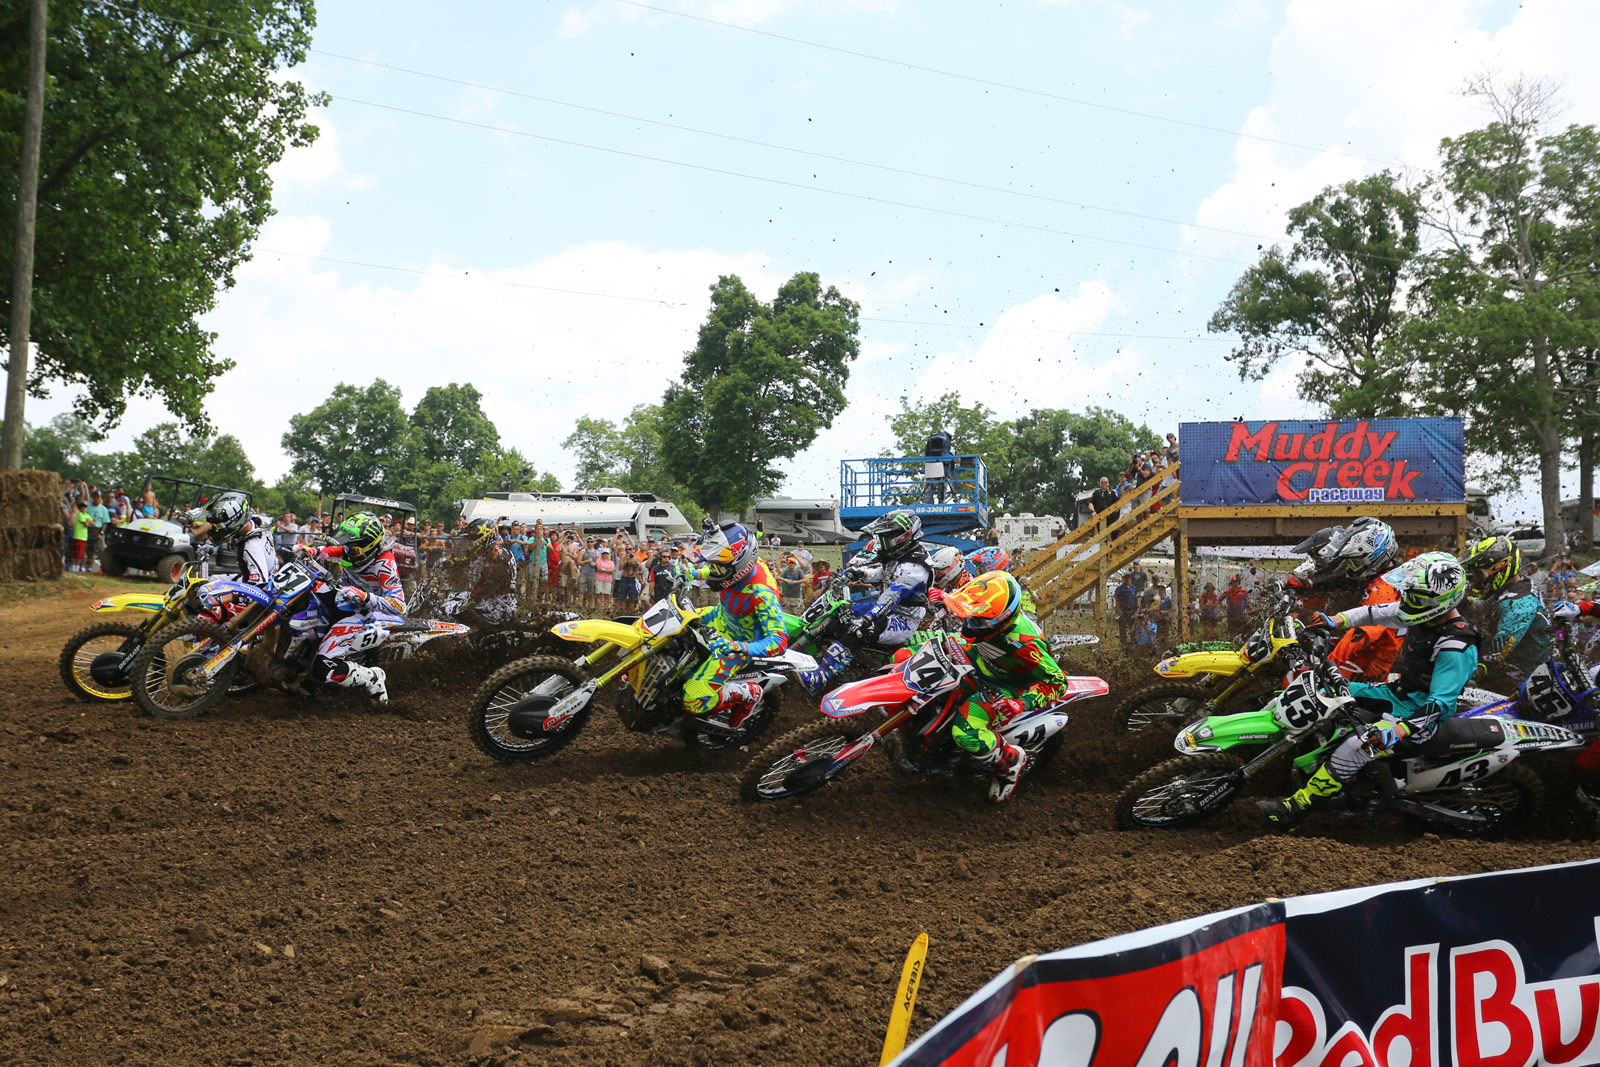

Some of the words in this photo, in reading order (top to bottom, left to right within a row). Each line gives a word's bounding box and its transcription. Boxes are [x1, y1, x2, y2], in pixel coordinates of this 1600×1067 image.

[1225, 421, 1398, 466] Muddy
[1277, 458, 1422, 501] Creek
[1309, 488, 1385, 502] raceway
[274, 564, 310, 593] 51
[720, 573, 740, 589] Red
[738, 561, 756, 579] Bull
[645, 607, 675, 628] 1
[361, 629, 378, 648] 51
[119, 645, 141, 671] DUNLOP
[908, 651, 949, 691] 14
[548, 701, 583, 726] DUNLOP
[1280, 684, 1319, 728] 43
[1562, 722, 1595, 733] YAMAHA
[1450, 743, 1477, 752] Kawasaki
[1517, 741, 1552, 750] DUNLOP
[1436, 758, 1490, 789] 43
[1199, 783, 1229, 807] DUNLOP
[904, 960, 920, 1012] ACERBIS
